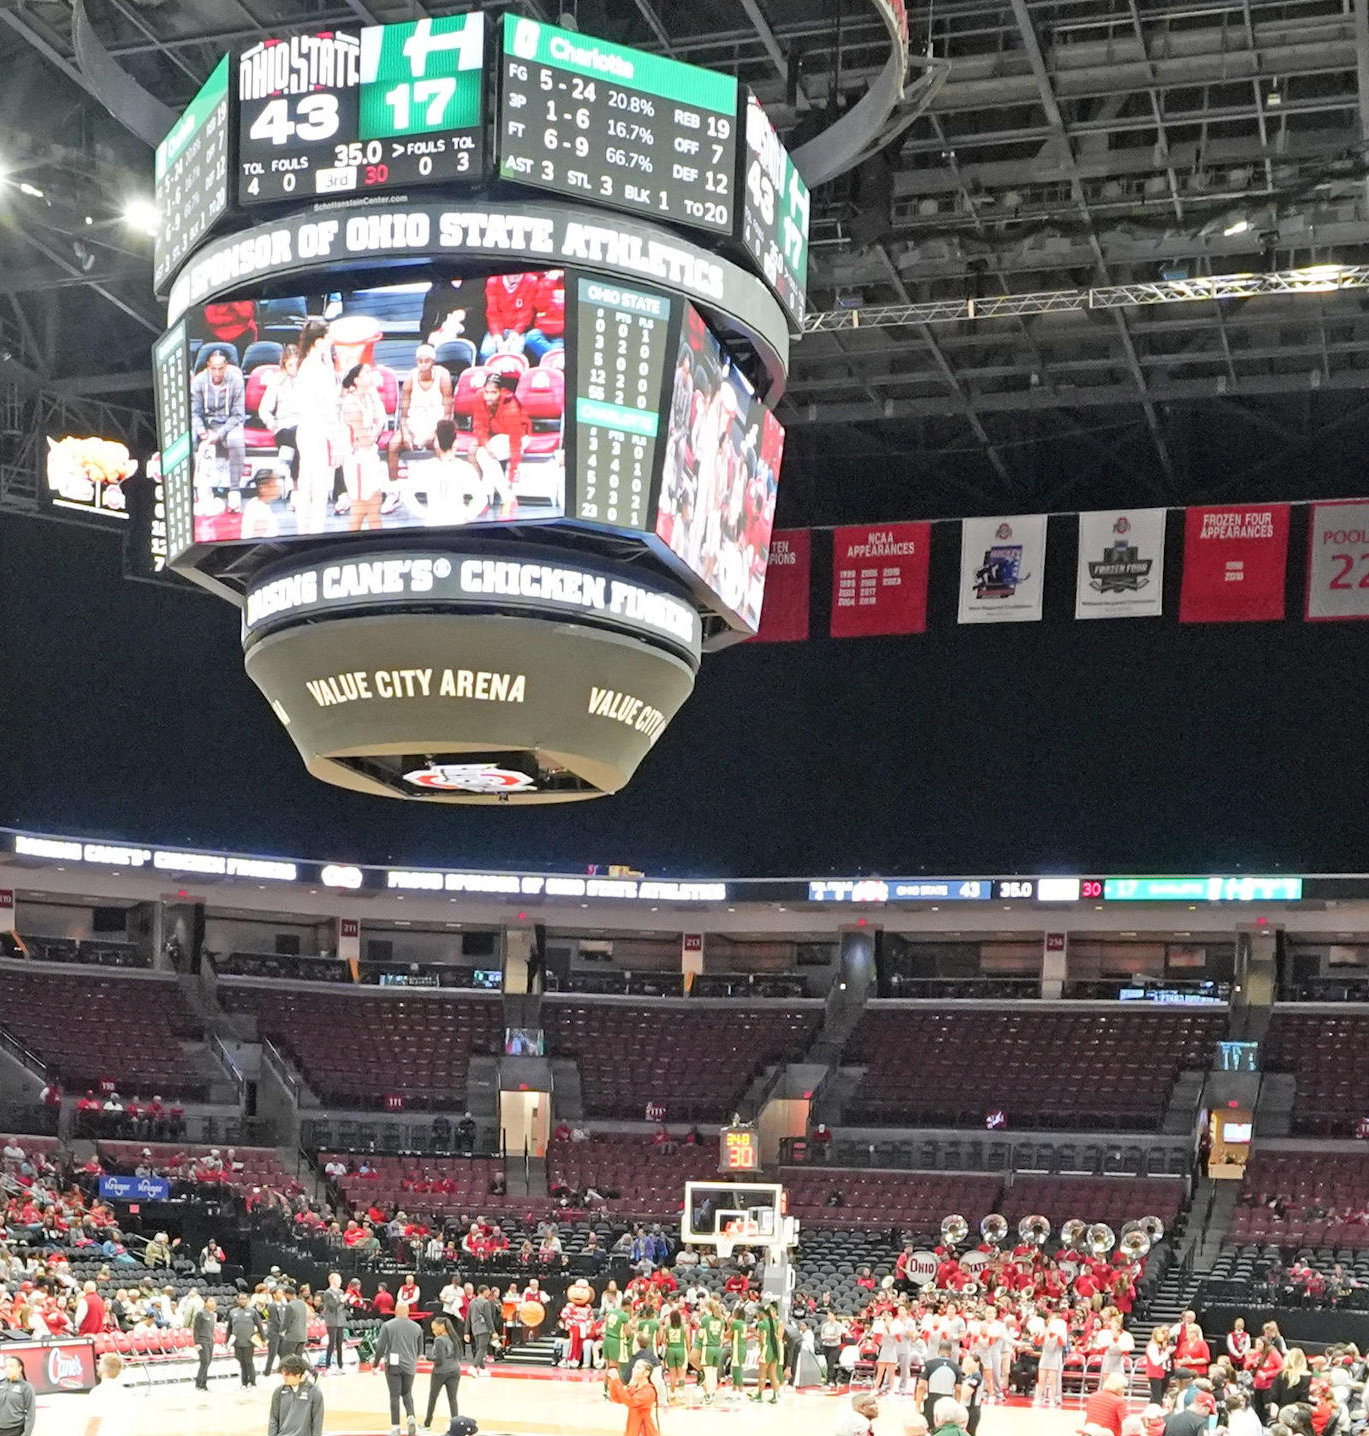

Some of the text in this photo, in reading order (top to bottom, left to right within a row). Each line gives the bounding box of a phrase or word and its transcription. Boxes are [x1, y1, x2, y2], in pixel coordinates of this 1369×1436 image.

[550, 36, 635, 80] Charlotte
[385, 77, 457, 130] 17
[509, 64, 730, 140] FG 5 24 20.8% REB 19
[249, 94, 339, 145] 43
[509, 93, 723, 165] 3P 1 6 16.7% OFF 7
[243, 136, 475, 175] TOL FOULS 35.0 FOULS TOL
[508, 121, 728, 194] FT 6 9 66.7% DEF 12
[247, 152, 469, 195] 4 0 3rd 30 0 3
[314, 194, 408, 212] SchottensteinCenter.com
[505, 155, 728, 225] AST 3 STL 3 BLK 1 TO 20
[190, 213, 725, 299] SPONSOR OF OHIO STATE ATHLETICS
[783, 215, 803, 270] 17
[588, 285, 660, 314] OHIO STATE
[1200, 524, 1273, 540] APPEARANCES
[1203, 513, 1272, 527] FROZEN FOUR
[772, 541, 789, 552] TEN
[847, 542, 915, 558] APPEARANCES
[869, 532, 894, 545] NCAA
[247, 570, 317, 626] RAISING
[461, 560, 606, 611] CHICKEN
[306, 668, 525, 706] VALUE CITY ARENA
[588, 687, 642, 732] VALUE
[959, 881, 980, 898] 43
[1000, 882, 1032, 898] 35.0
[1082, 882, 1101, 898] 30
[389, 1098, 402, 1107] 111
[729, 1146, 752, 1167] 30
[105, 1178, 163, 1197] Kroger Kroger
[910, 1258, 934, 1274] OHIO
[970, 1262, 987, 1273] TATE
